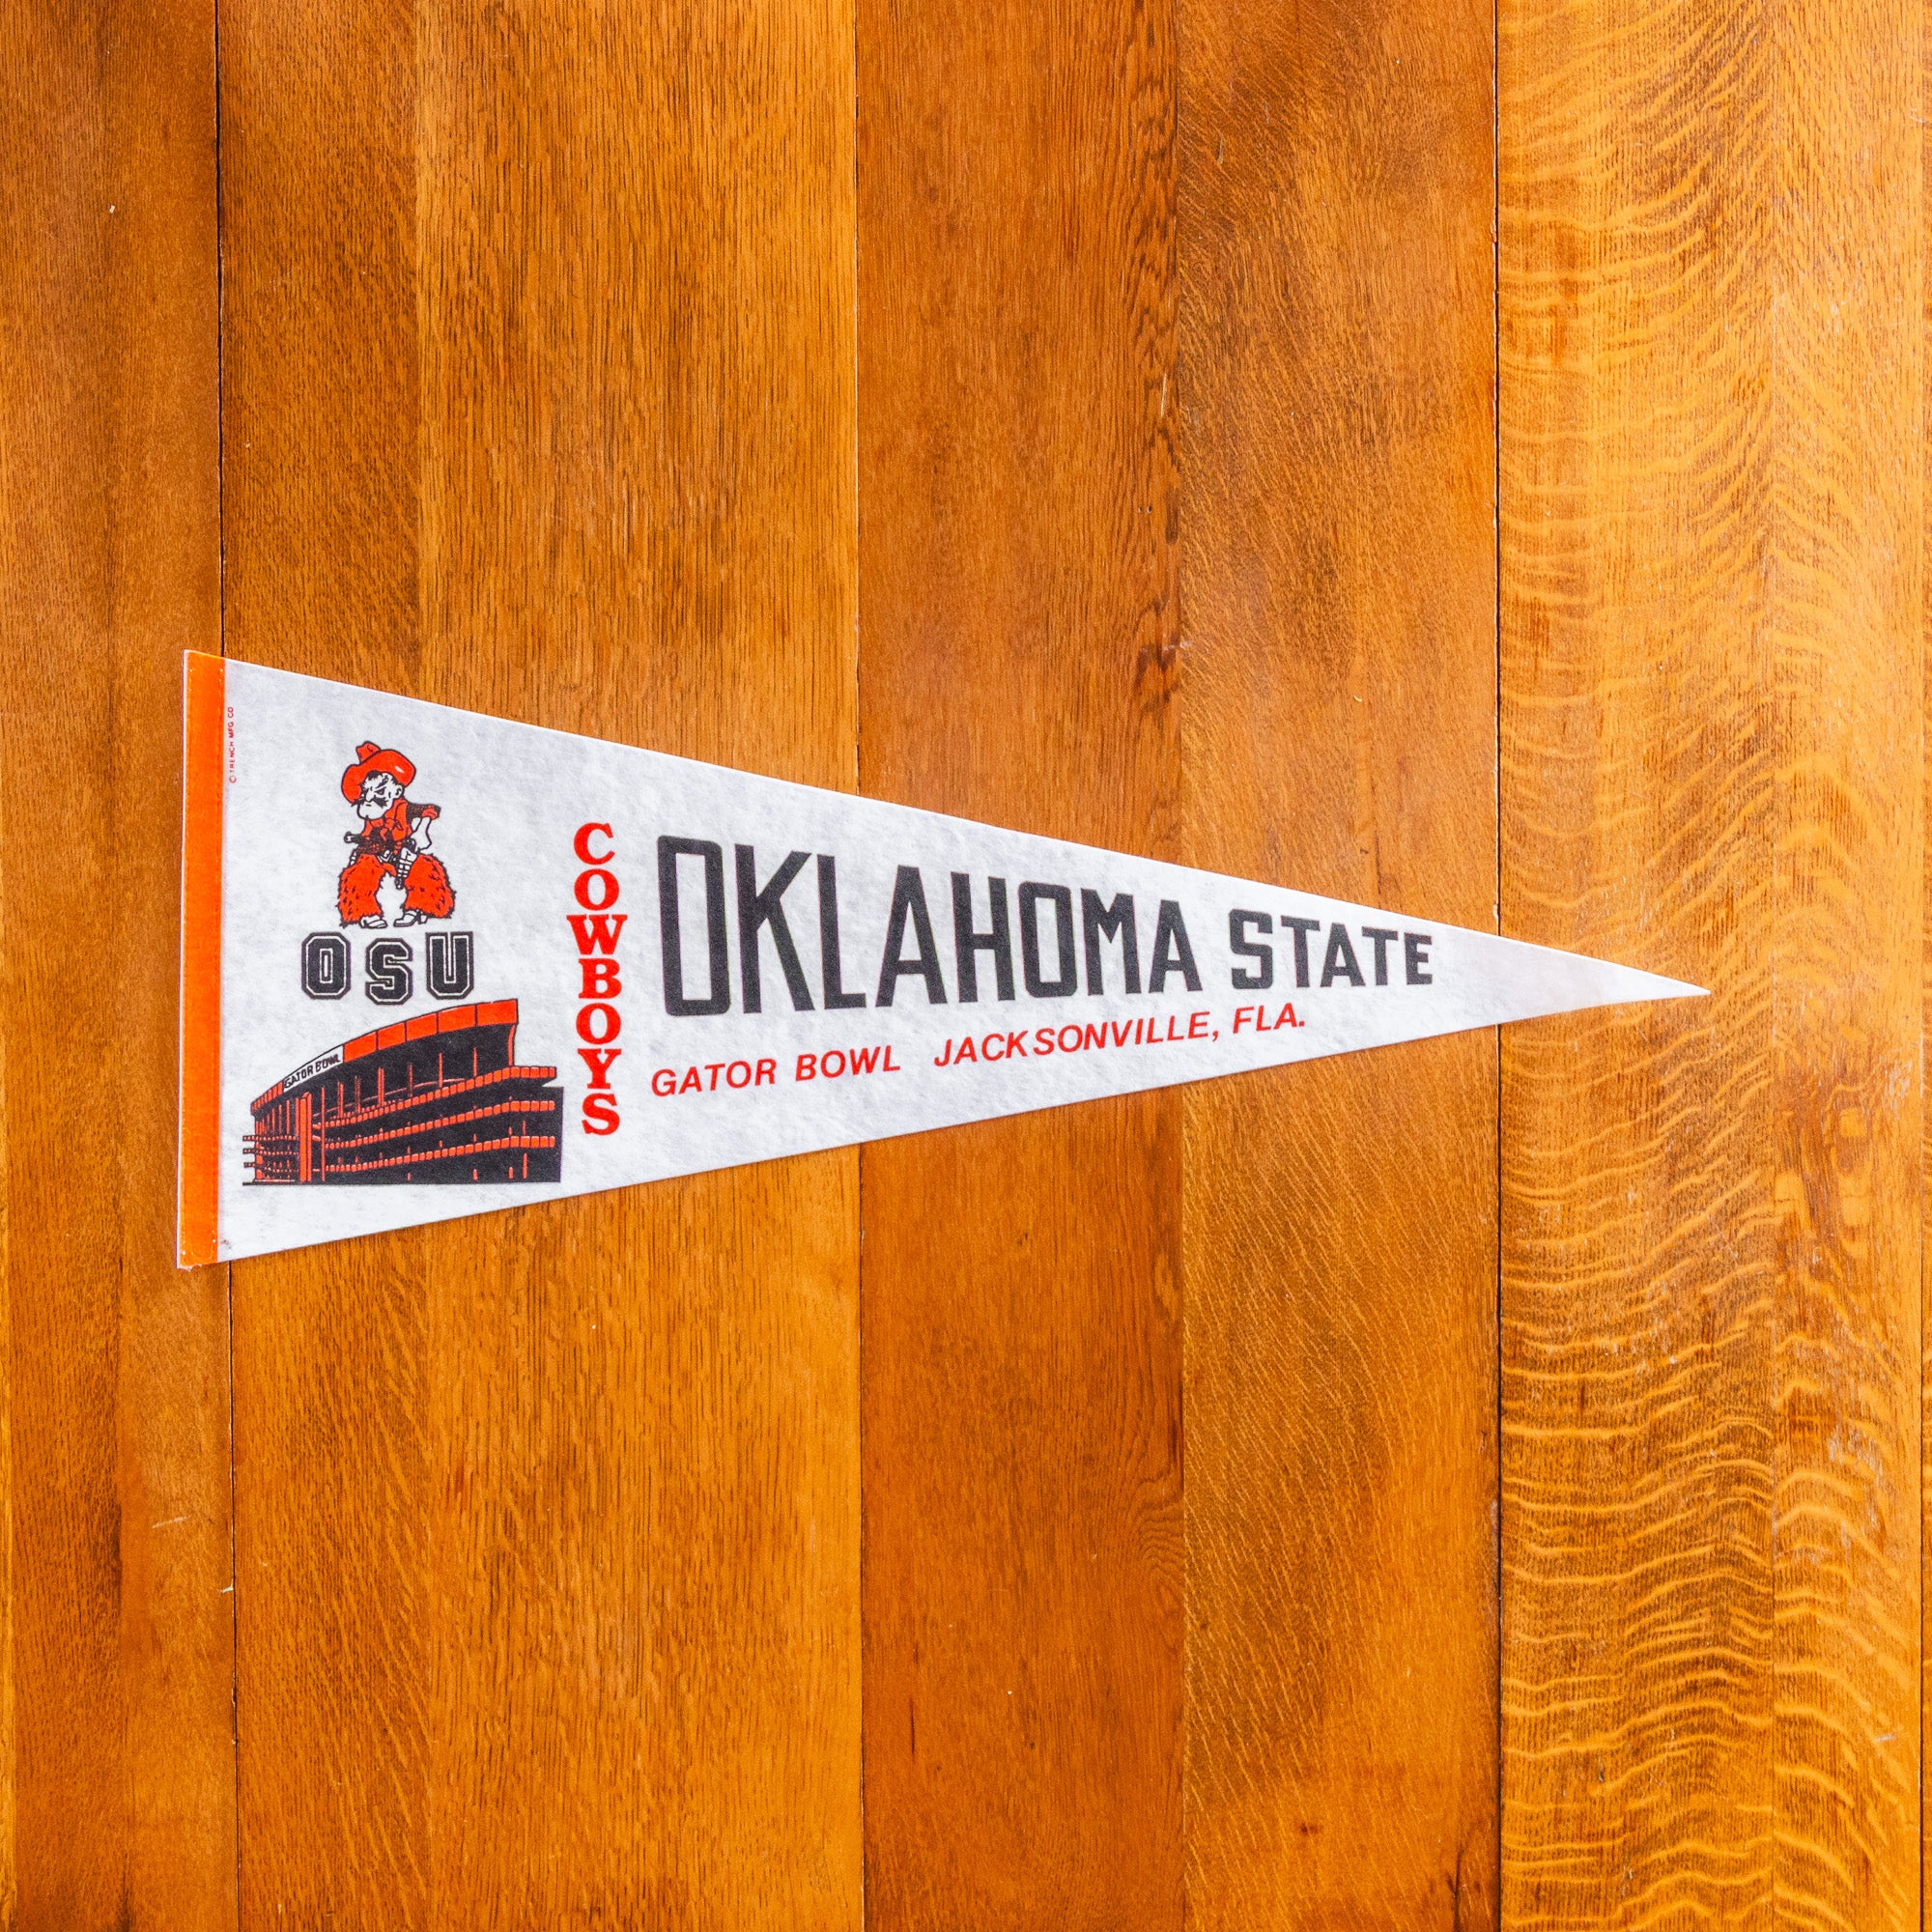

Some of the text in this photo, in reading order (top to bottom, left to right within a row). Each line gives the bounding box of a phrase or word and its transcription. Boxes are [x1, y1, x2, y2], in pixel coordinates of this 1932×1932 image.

[227, 706, 234, 719] CO
[301, 931, 474, 1006] OSU
[658, 836, 1433, 1016] OKLAHOMA STATE
[567, 822, 628, 1136] COWBOYS
[284, 1054, 341, 1089] GATOR BOWL
[651, 1002, 1305, 1097] GATOR BOWL JACKSONVILLE, FLA.
